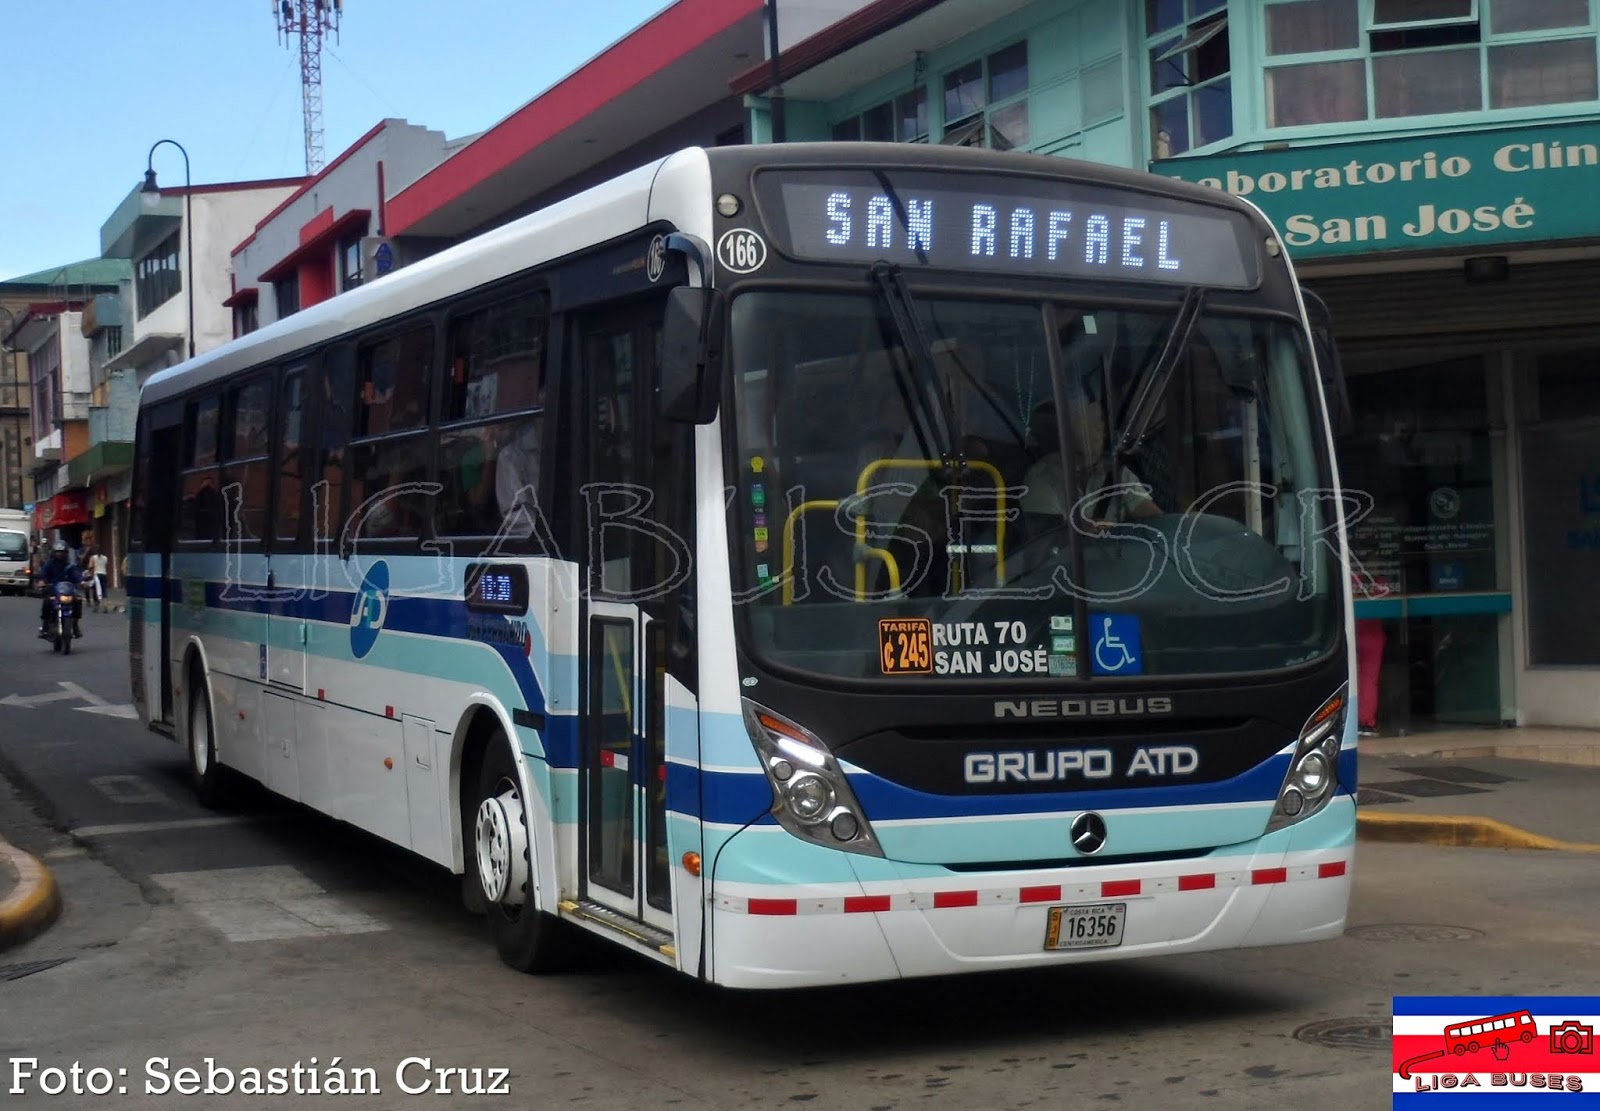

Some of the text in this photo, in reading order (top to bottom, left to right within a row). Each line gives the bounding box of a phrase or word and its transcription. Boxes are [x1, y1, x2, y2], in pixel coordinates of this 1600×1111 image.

[1170, 151, 1471, 196] aboratorio
[826, 193, 1180, 270] SAN RAFAEL
[1285, 197, 1535, 246] San José
[726, 234, 756, 267] 166
[881, 622, 926, 633] TARIFA
[932, 621, 1027, 646] RUTA 70
[897, 633, 929, 669] 245
[934, 645, 1048, 674] SAN JOSÉ
[994, 697, 1172, 718] NEOBUS
[964, 746, 1198, 783] GRUPO ATD
[1068, 915, 1117, 939] 16356
[1060, 939, 1108, 947] CENTROAMERICA
